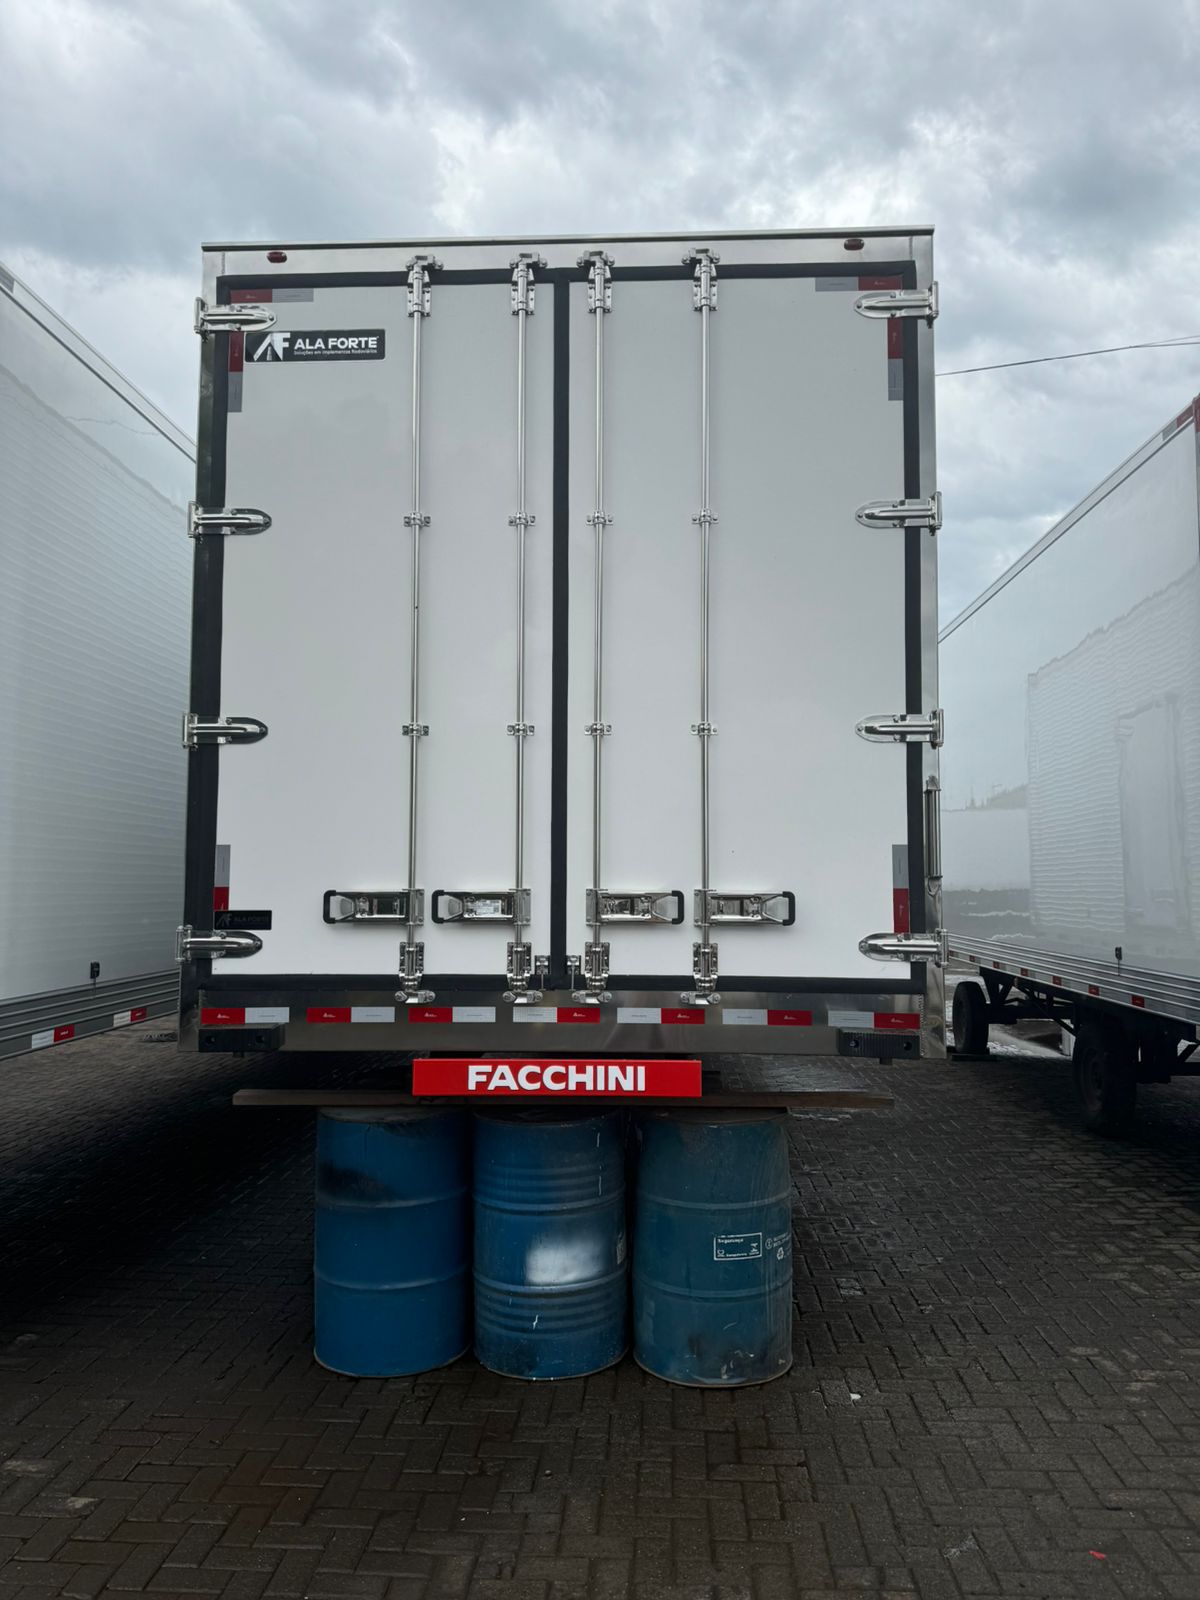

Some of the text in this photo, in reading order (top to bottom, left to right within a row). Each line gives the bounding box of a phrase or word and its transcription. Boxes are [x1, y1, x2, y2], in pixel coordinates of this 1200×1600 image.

[294, 337, 377, 350] ALA FORTE
[467, 1064, 645, 1091] FACCHINI
